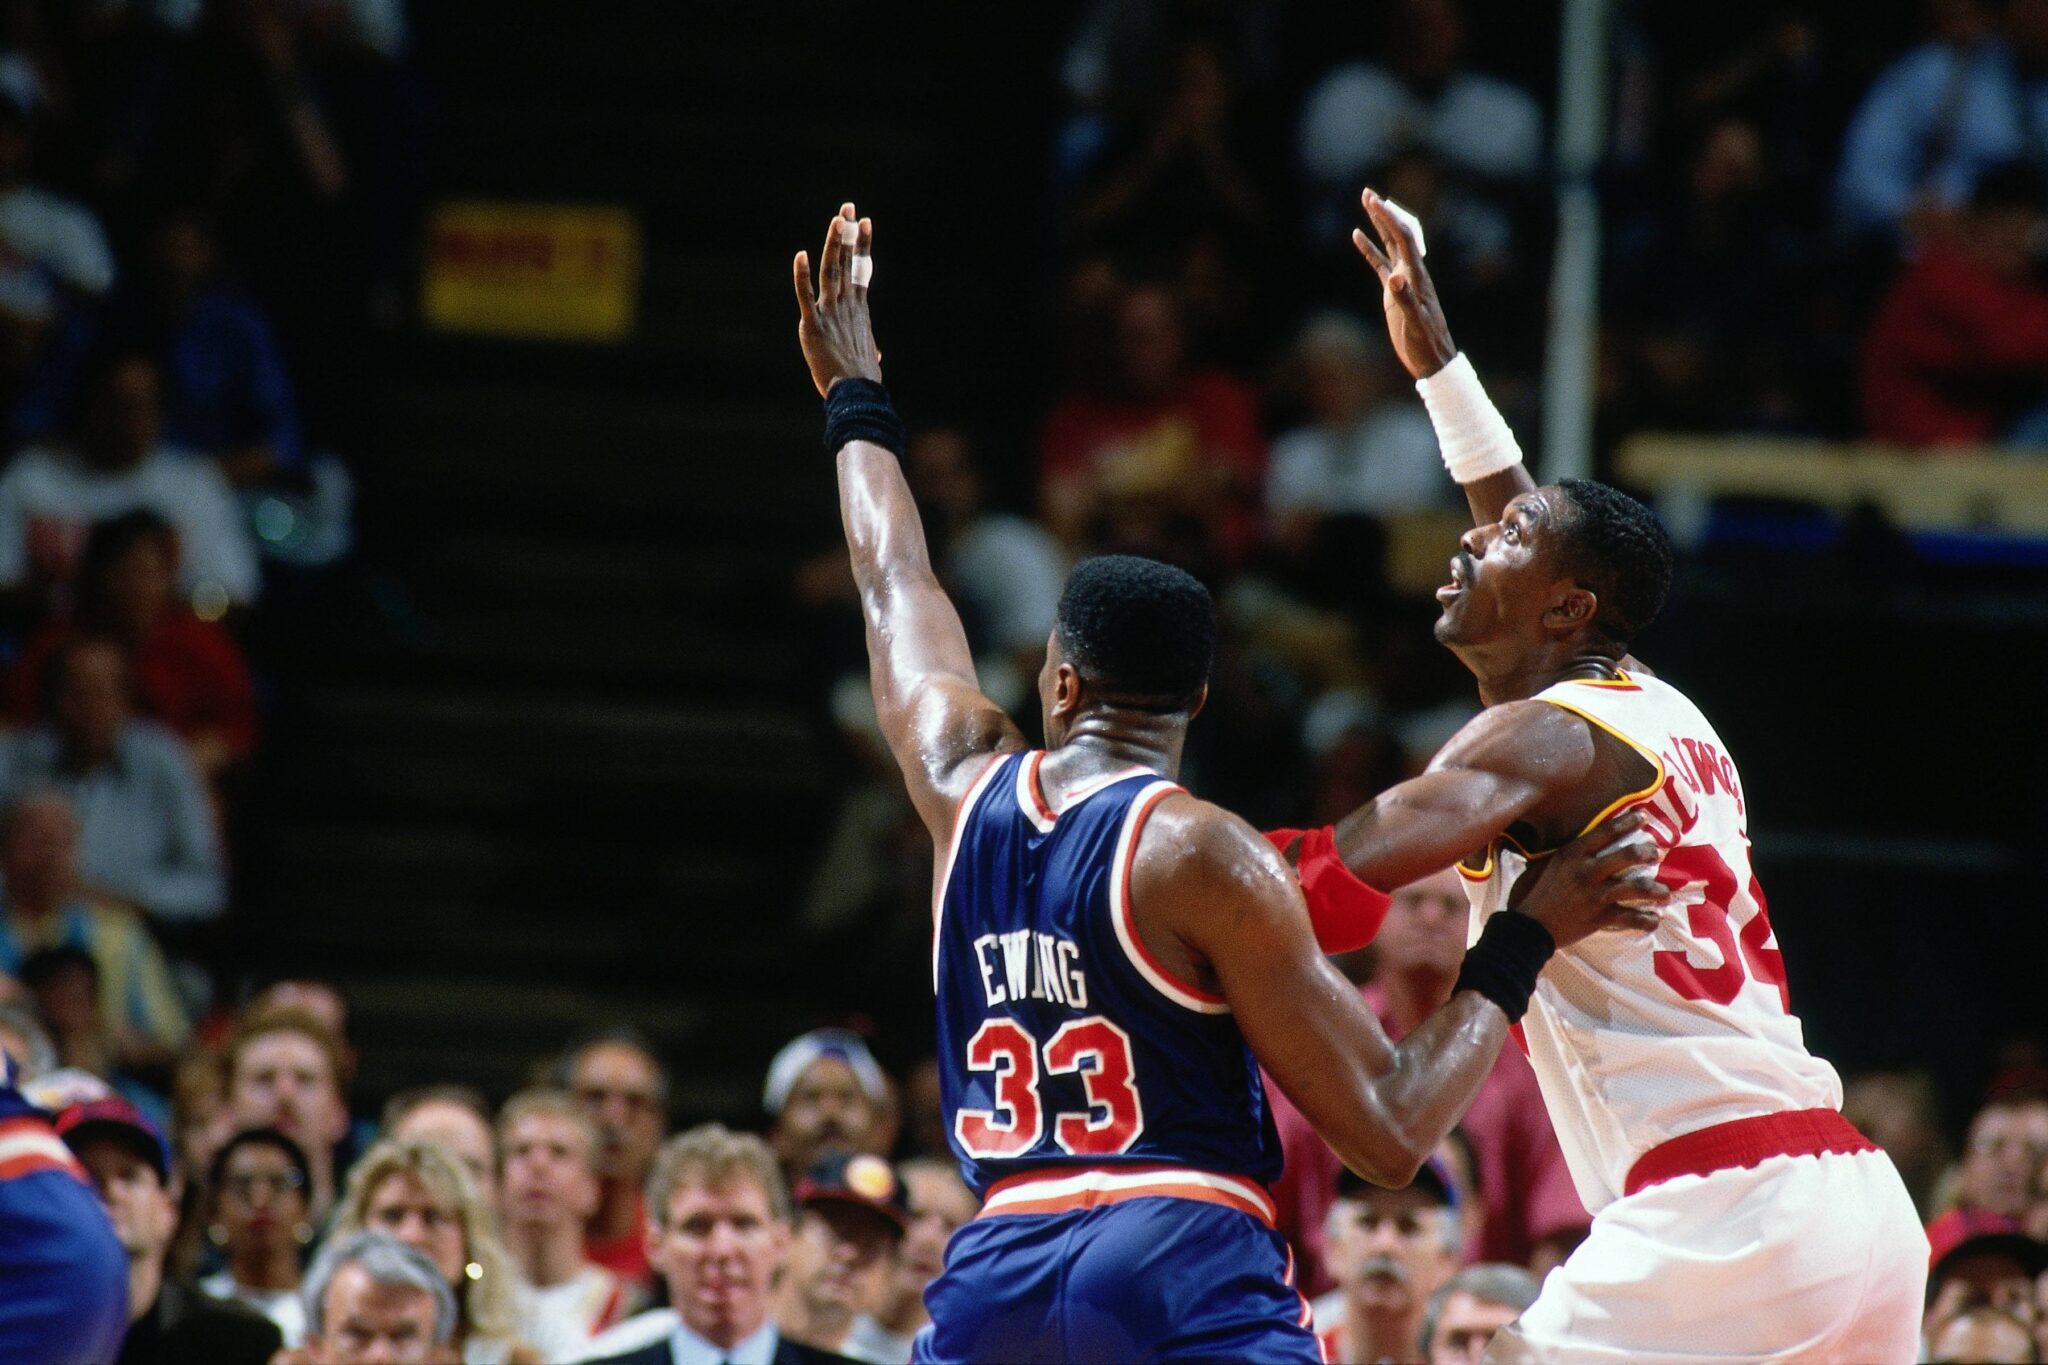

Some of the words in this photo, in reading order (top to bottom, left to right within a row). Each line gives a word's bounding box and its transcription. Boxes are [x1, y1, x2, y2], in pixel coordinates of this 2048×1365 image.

[973, 928, 1088, 1009] EWING
[1653, 843, 1791, 1016] 34
[954, 1014, 1145, 1160] 33
